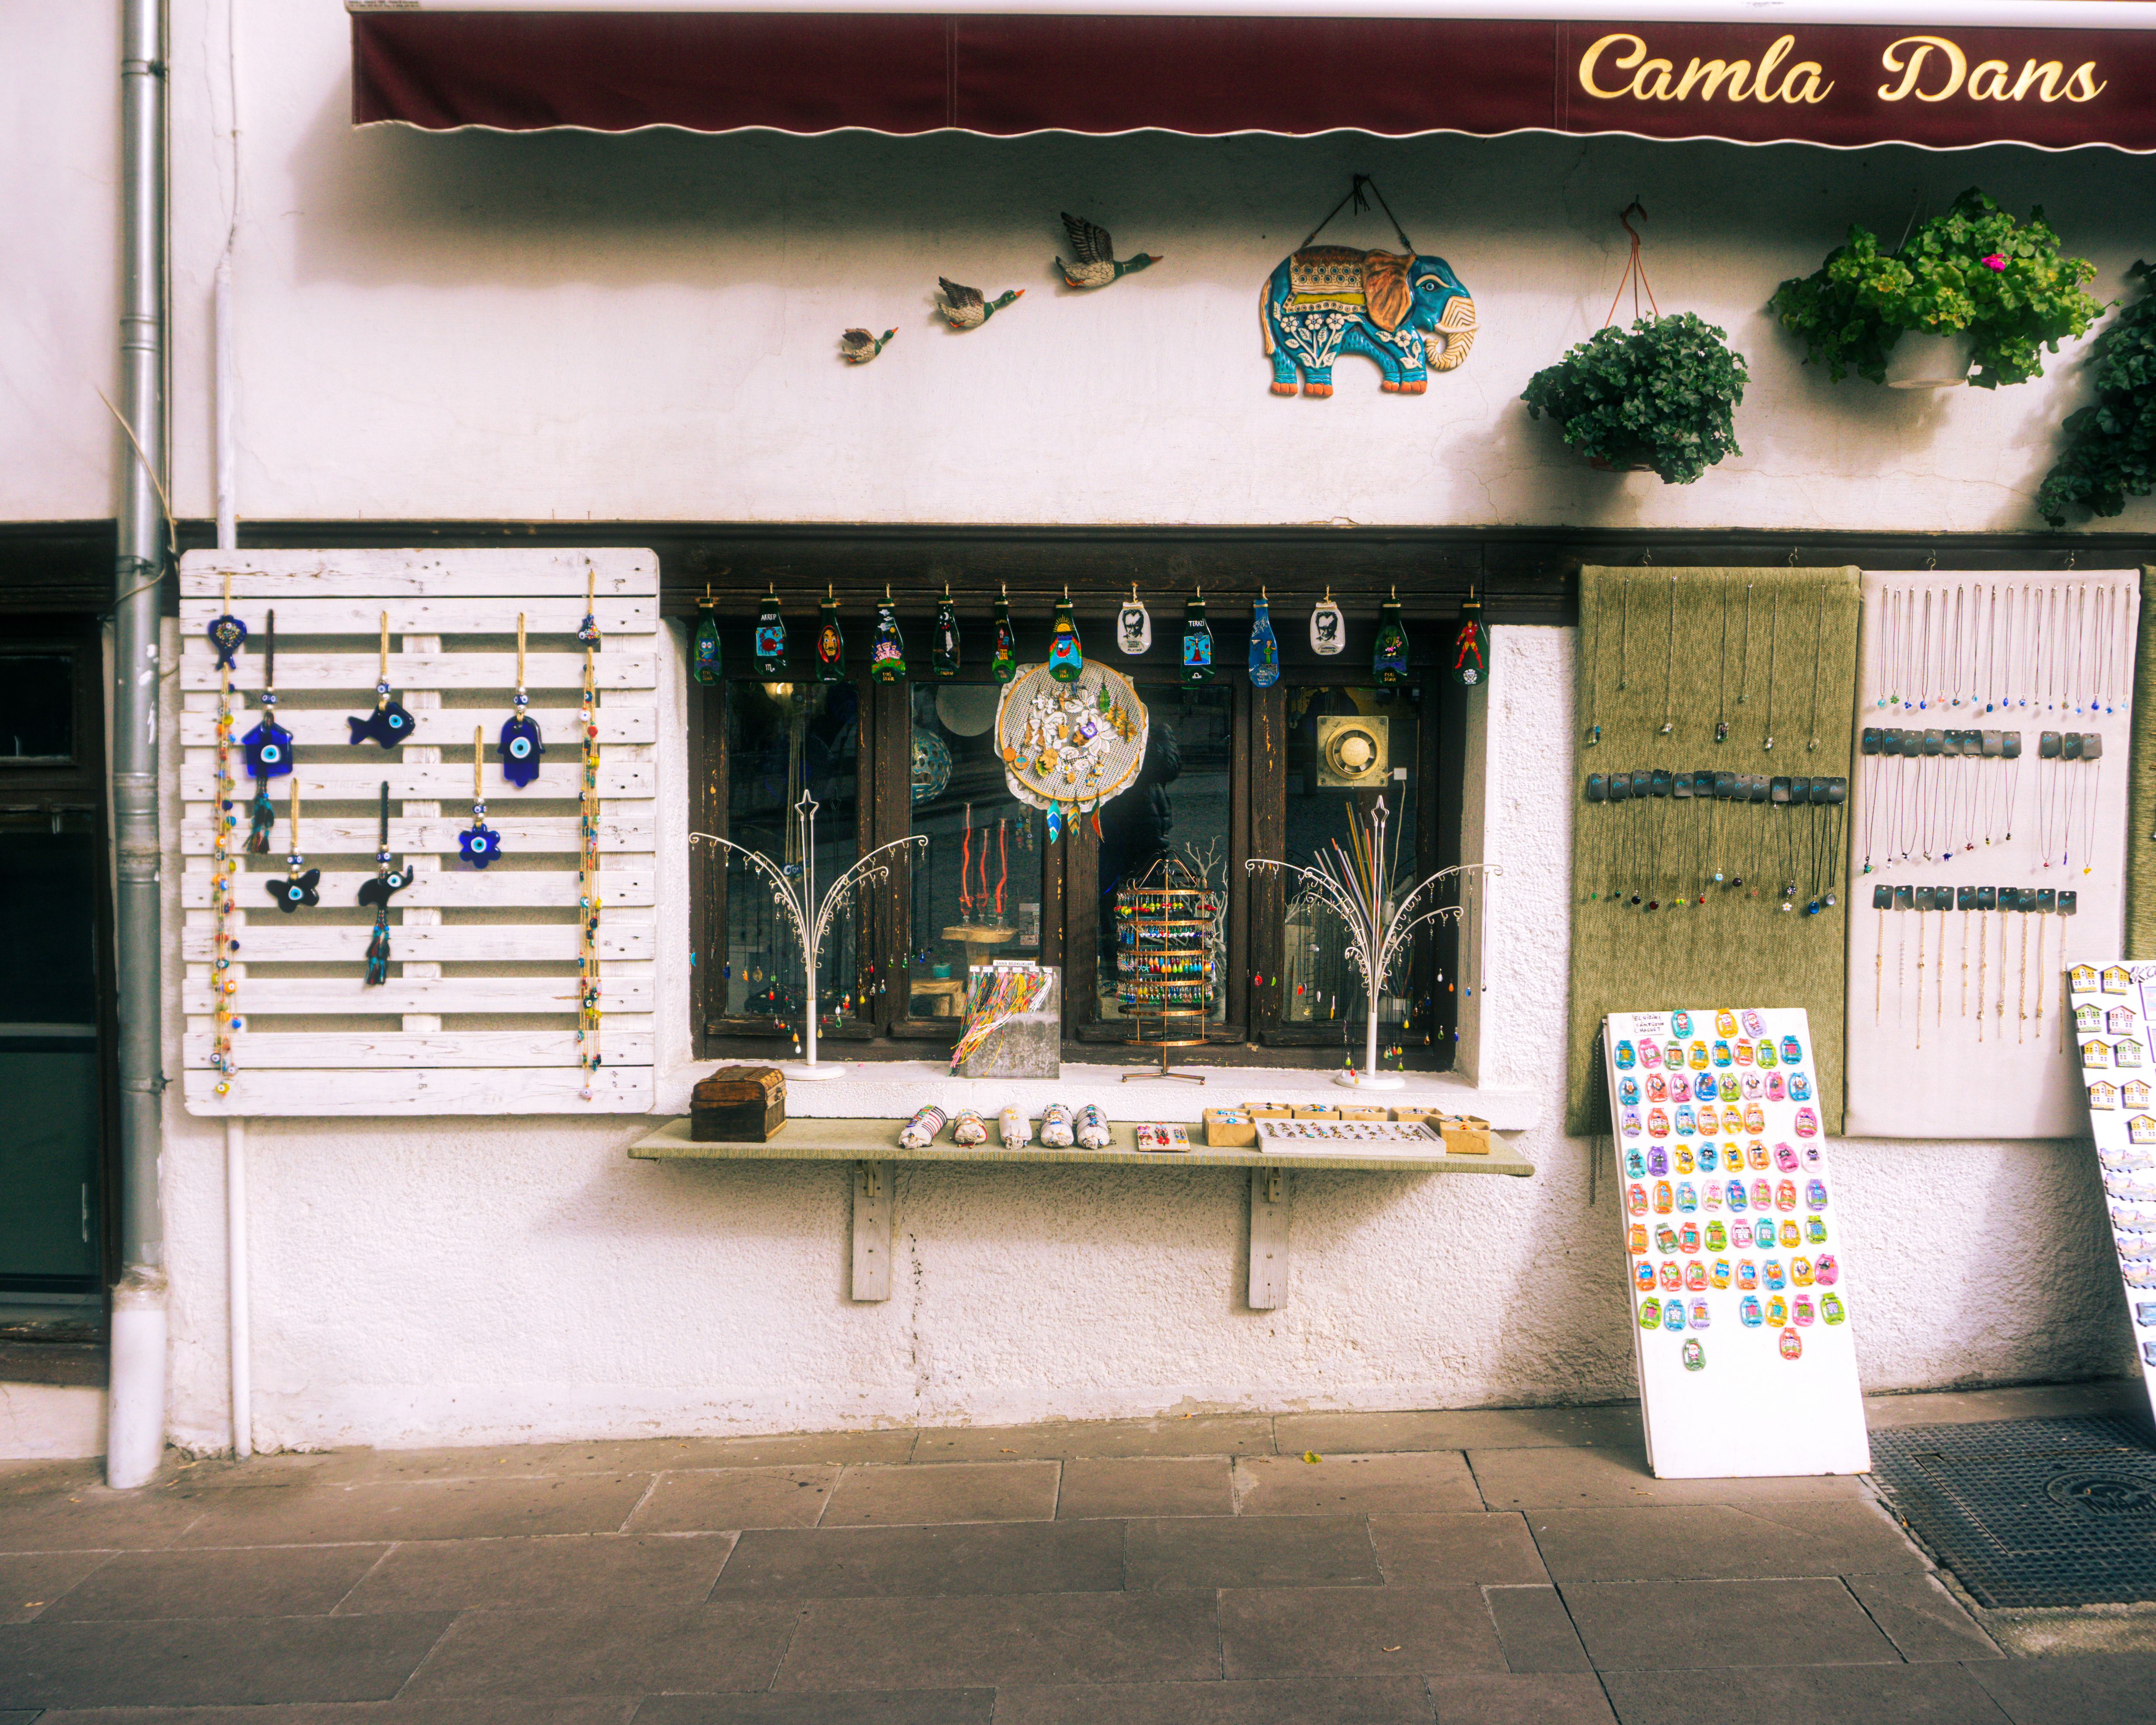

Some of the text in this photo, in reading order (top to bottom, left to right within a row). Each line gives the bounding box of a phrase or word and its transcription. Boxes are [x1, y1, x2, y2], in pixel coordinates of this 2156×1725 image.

[1579, 33, 2107, 103] Camla Dans
[1188, 618, 1205, 627] TERAZİ
